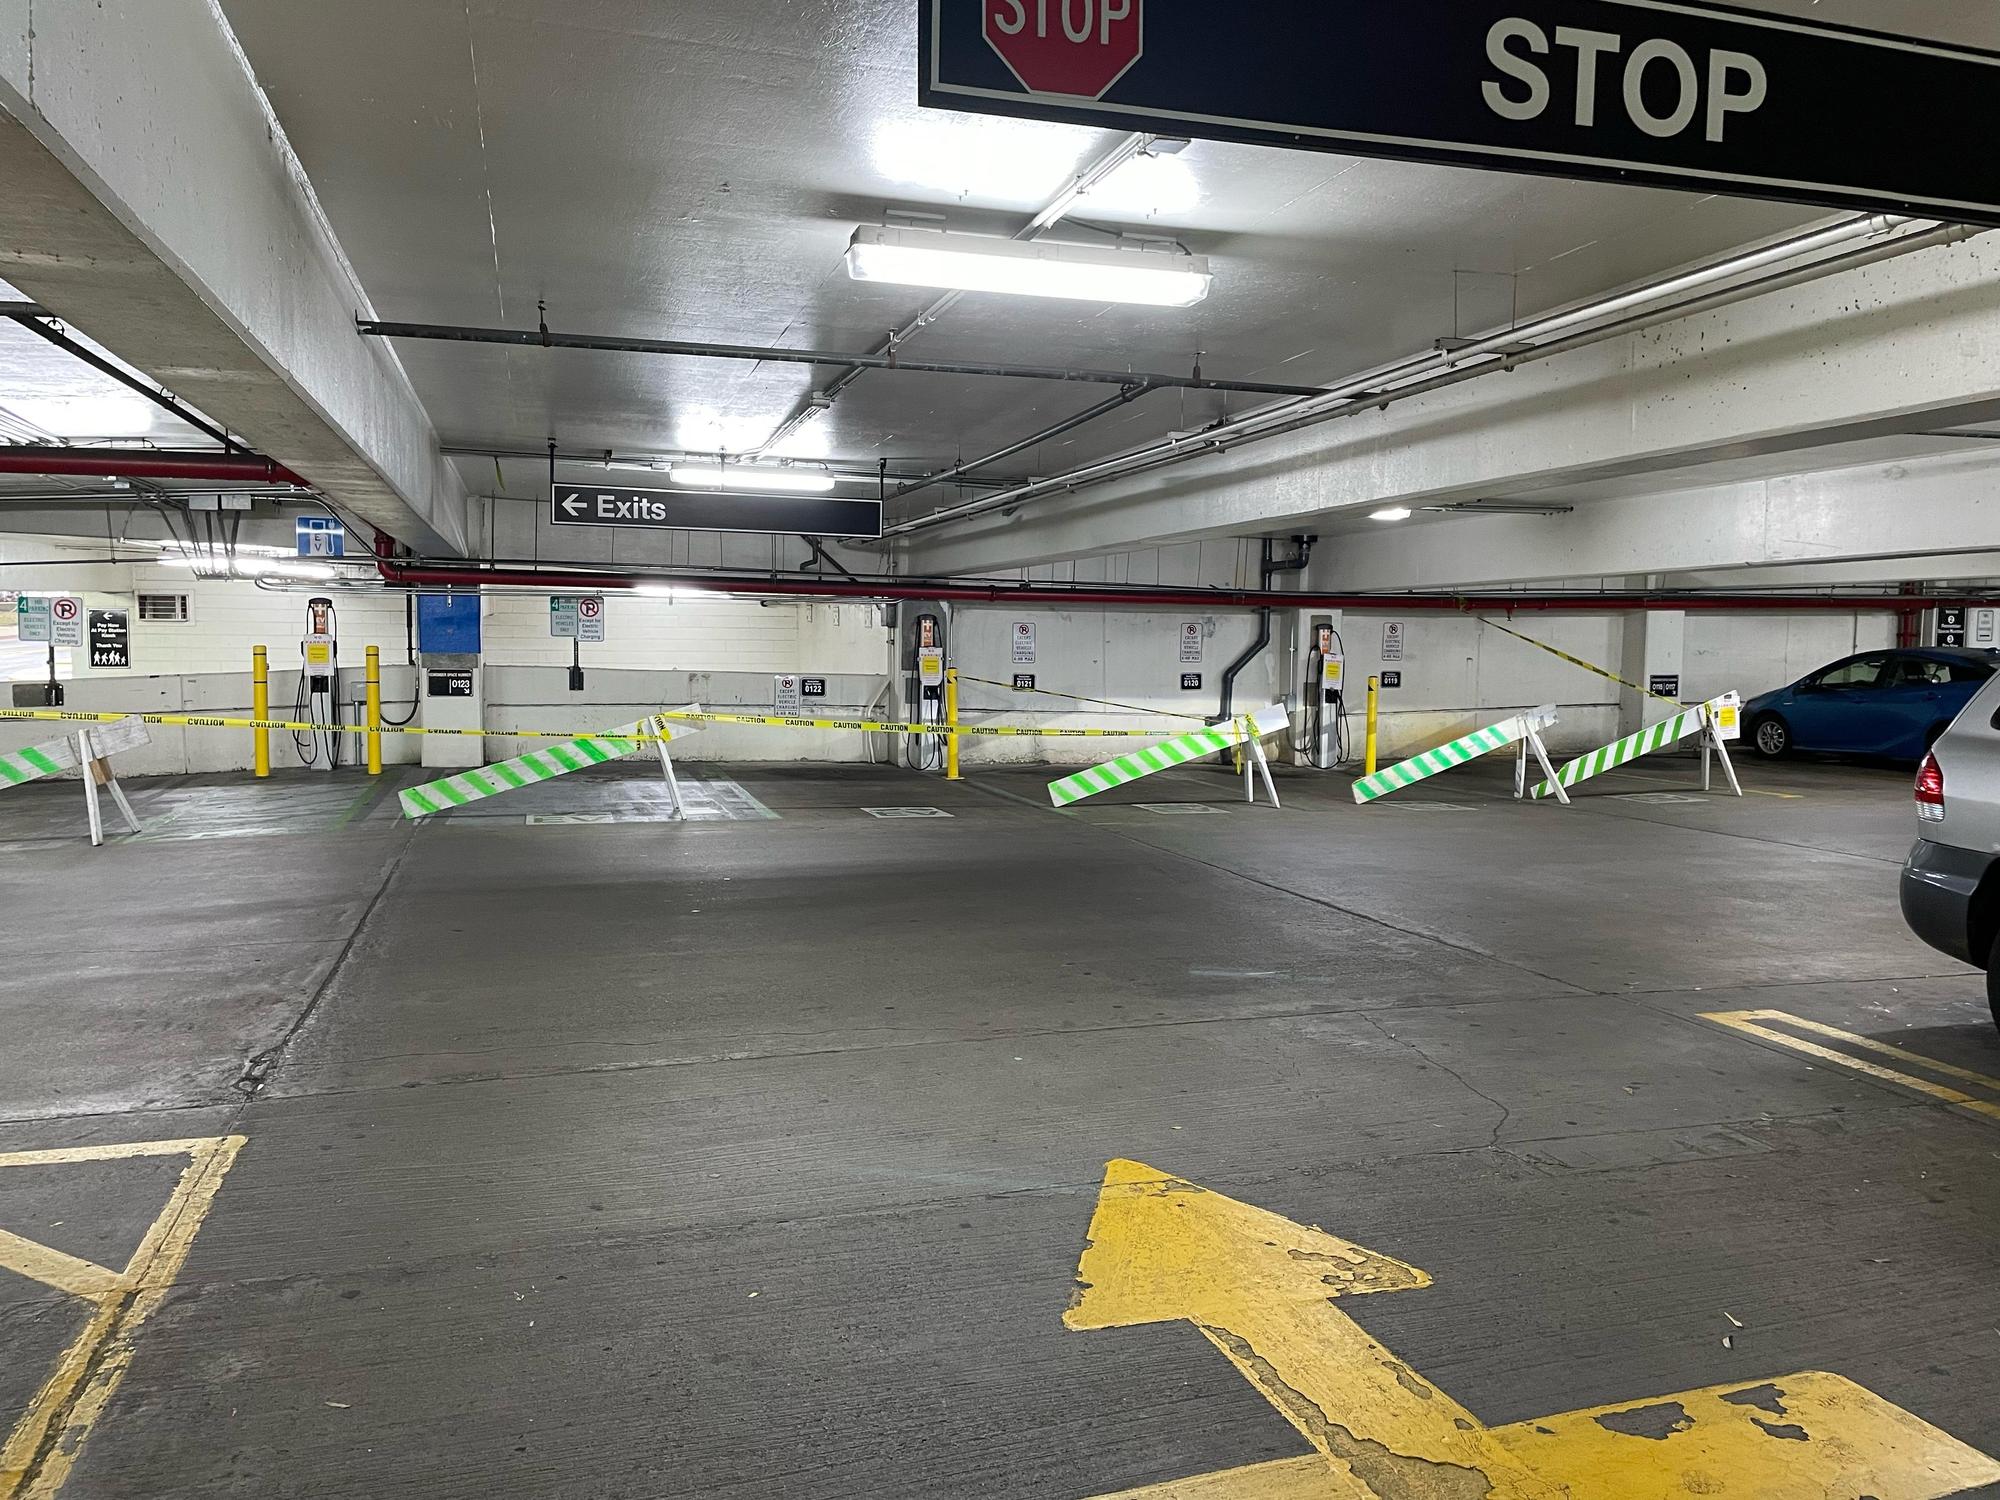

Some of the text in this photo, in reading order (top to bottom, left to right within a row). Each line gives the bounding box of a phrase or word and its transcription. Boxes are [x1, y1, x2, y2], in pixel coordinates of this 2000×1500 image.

[994, 0, 1131, 45] STOP
[1481, 17, 1768, 143] STOP
[597, 494, 666, 521] Exits
[19, 601, 28, 611] 4
[551, 598, 559, 610] 4
[53, 620, 71, 628] Except
[451, 679, 470, 688] 0123
[1016, 680, 1032, 688] 0121
[1183, 679, 1199, 687] 0120
[804, 685, 822, 693] 0122
[736, 716, 766, 724] CAUTION
[785, 719, 815, 727] CAUTION
[833, 721, 862, 729] CAUTION
[880, 724, 909, 732] CAUTION
[926, 725, 954, 734] CAUTION
[971, 727, 999, 735] CAUTION
[1016, 728, 1043, 736] CAUTION
